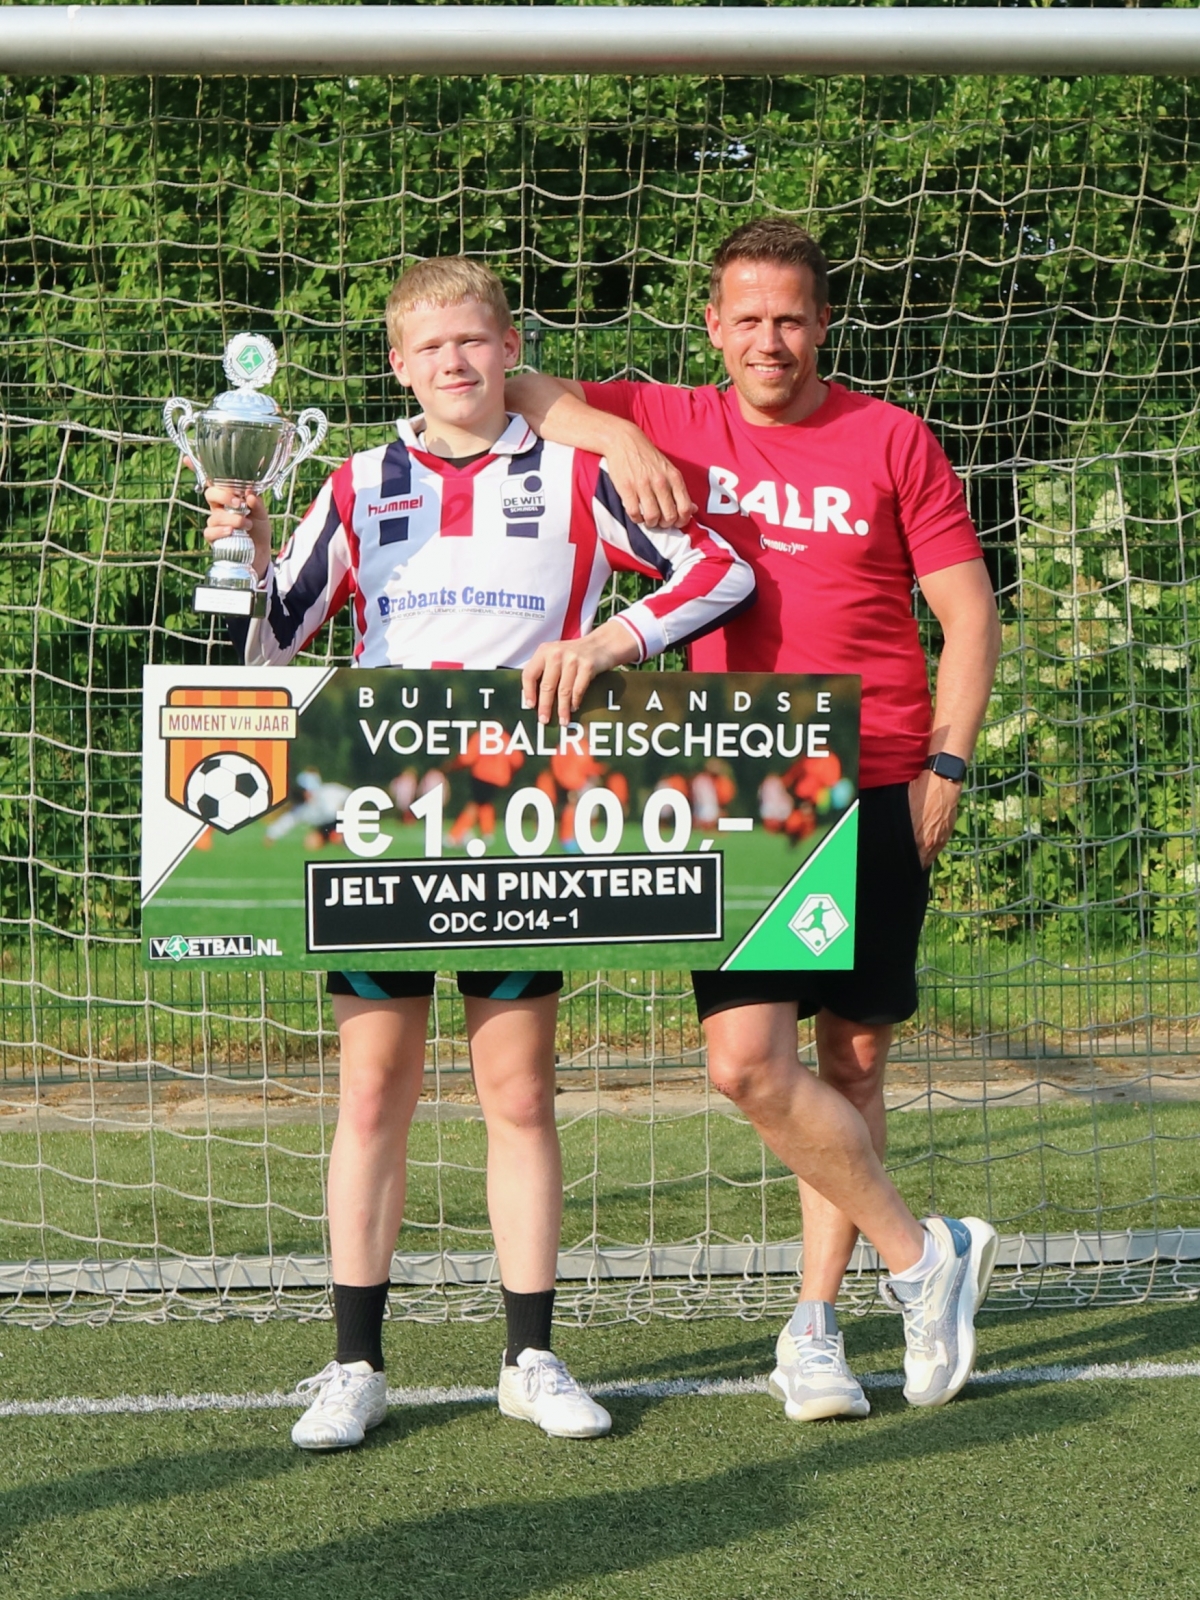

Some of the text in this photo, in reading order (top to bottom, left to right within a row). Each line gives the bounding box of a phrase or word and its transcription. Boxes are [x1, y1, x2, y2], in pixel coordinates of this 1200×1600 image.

[368, 495, 423, 517] hummel
[503, 496, 543, 507] DE WIT
[707, 465, 869, 536] BALR.
[377, 586, 546, 616] Brabants Centrum
[358, 687, 831, 713] BUITLANDSE
[168, 714, 289, 731] MOMENT V/H JAAR
[359, 719, 830, 758] VOETBALREISCHEQUE
[324, 866, 702, 906] JELT VAN PINXTEREN
[429, 908, 579, 933] ODC JO14-1
